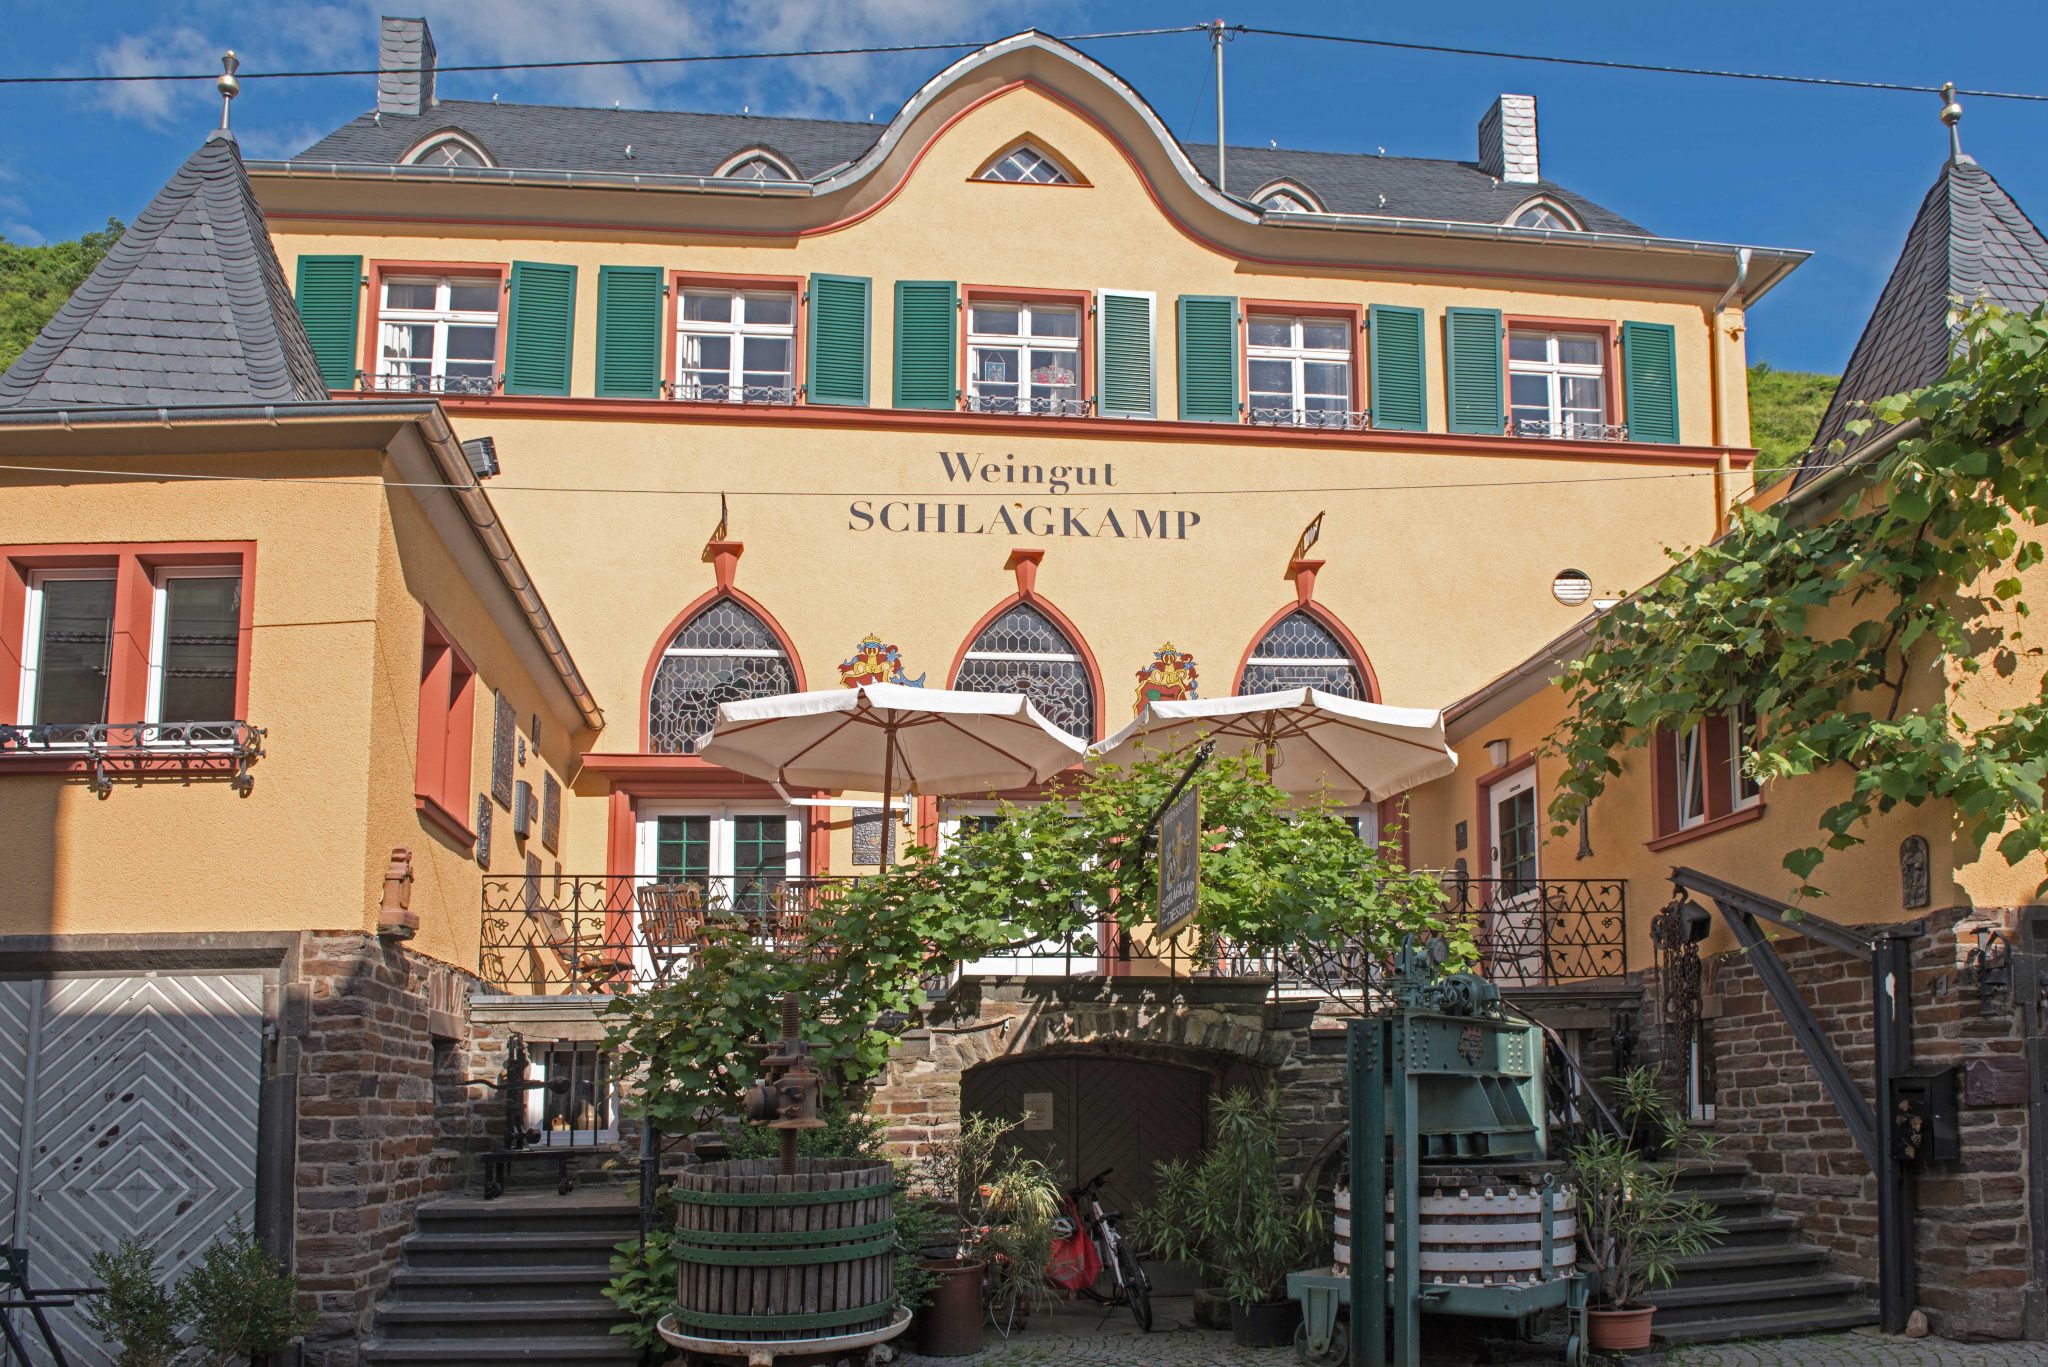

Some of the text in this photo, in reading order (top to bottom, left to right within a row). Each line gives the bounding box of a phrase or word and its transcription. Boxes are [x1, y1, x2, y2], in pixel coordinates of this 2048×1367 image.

[936, 451, 1118, 494] Weingut
[849, 501, 1200, 539] SCHLAGKAMP
[1161, 880, 1195, 912] SCHLAGKAMP
